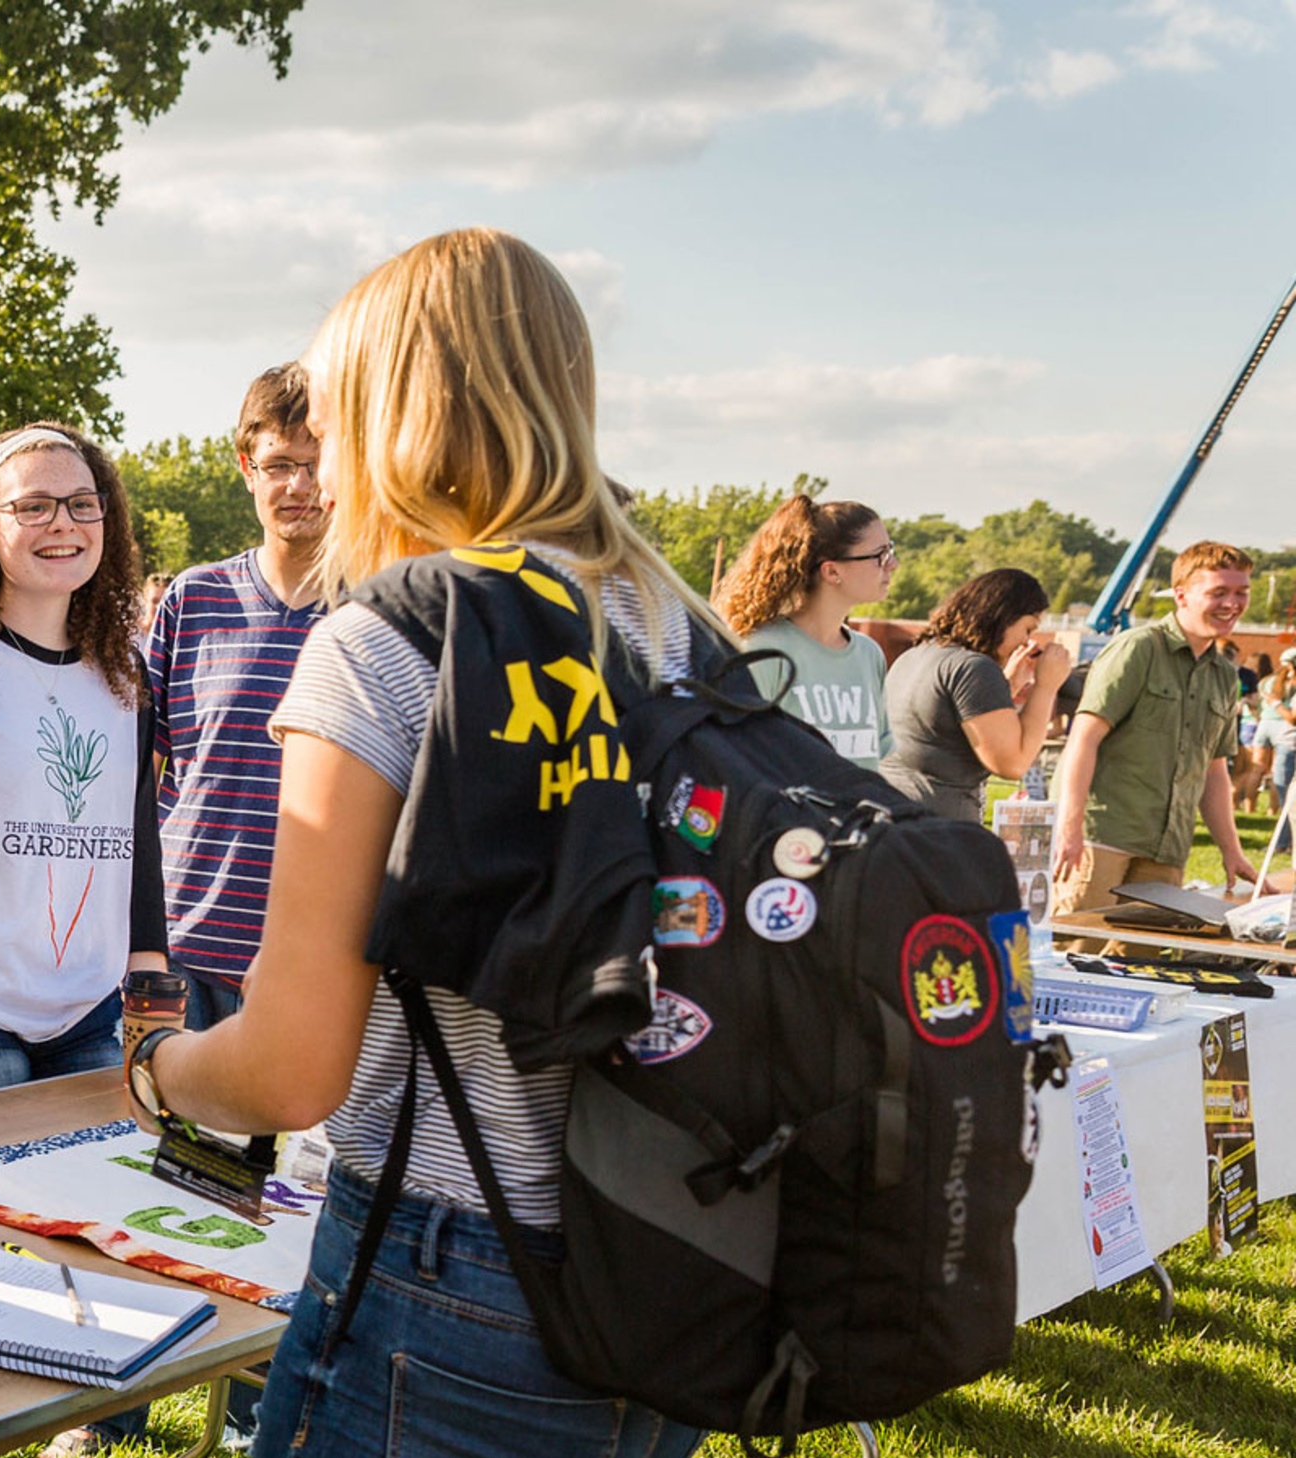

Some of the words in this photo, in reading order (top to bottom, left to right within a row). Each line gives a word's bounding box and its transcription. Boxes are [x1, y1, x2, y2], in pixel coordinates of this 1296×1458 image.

[4, 820, 30, 834] THE
[91, 825, 108, 838] OF
[2, 833, 134, 860] GARDENERS
[942, 1095, 975, 1286] patagonia
